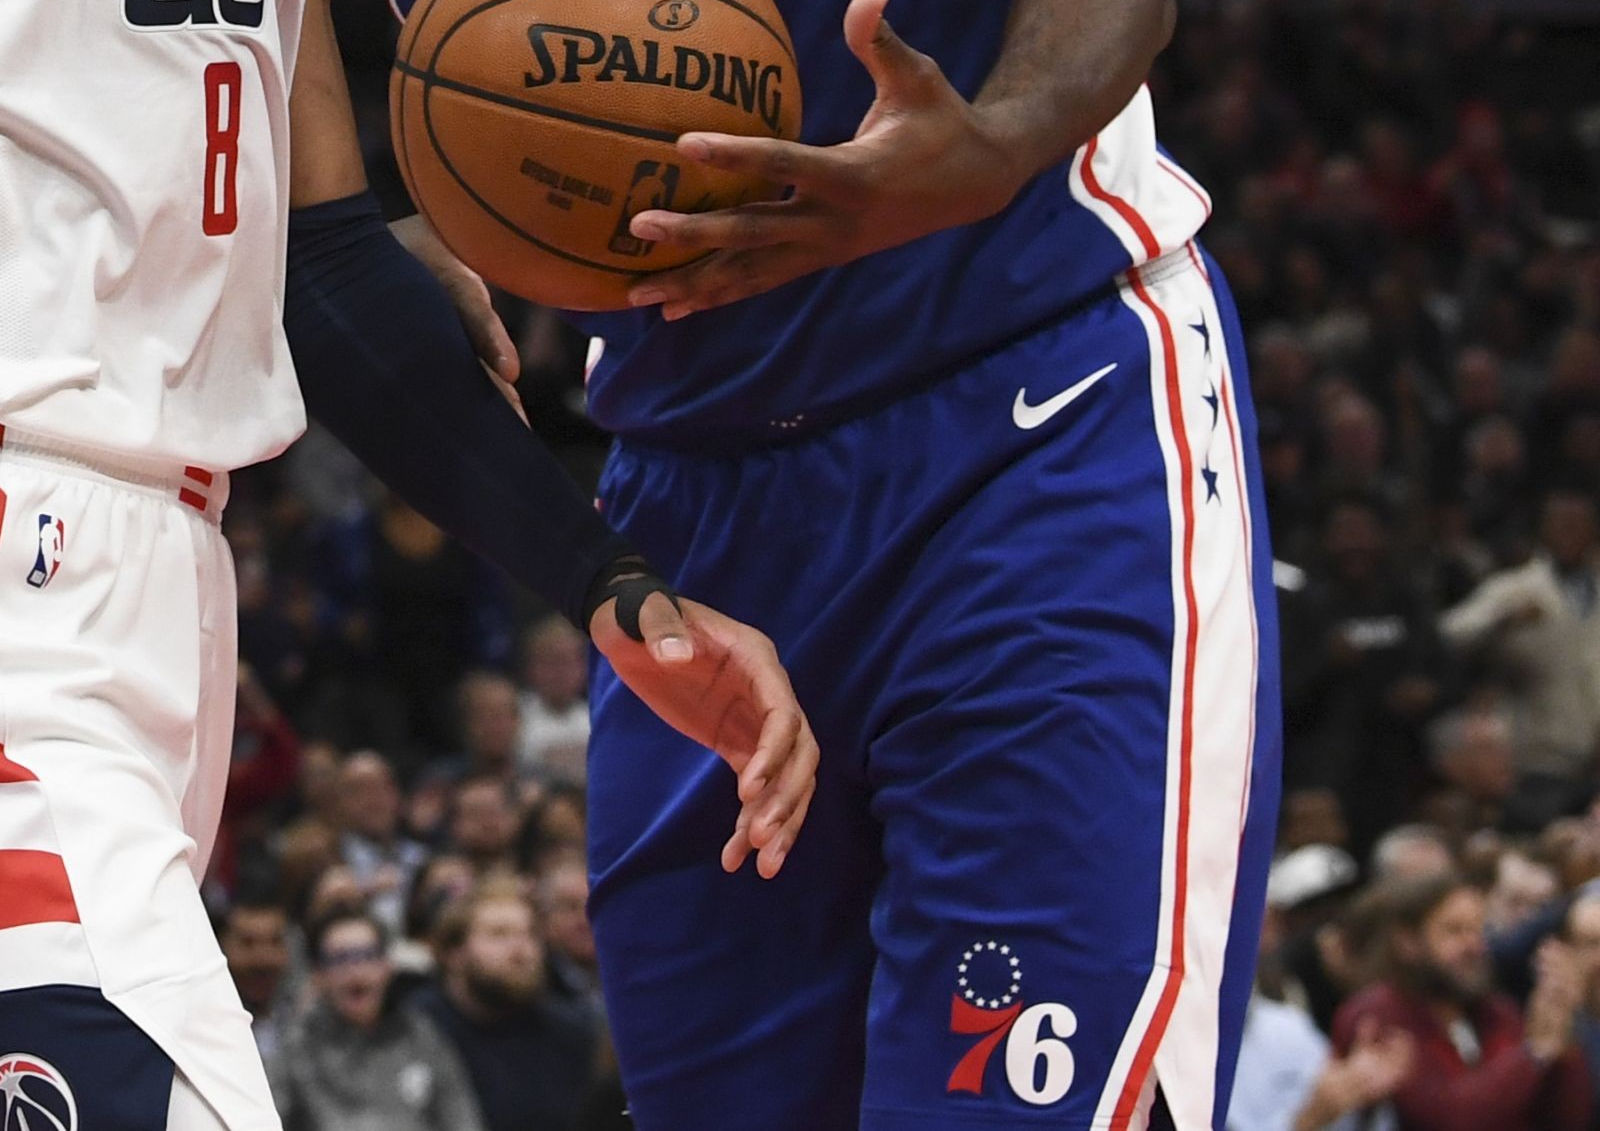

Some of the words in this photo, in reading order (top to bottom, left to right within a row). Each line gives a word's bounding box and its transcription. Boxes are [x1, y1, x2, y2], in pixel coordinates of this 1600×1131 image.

[524, 22, 783, 137] SPALDING
[202, 61, 242, 237] 8
[946, 992, 1078, 1106] 76
